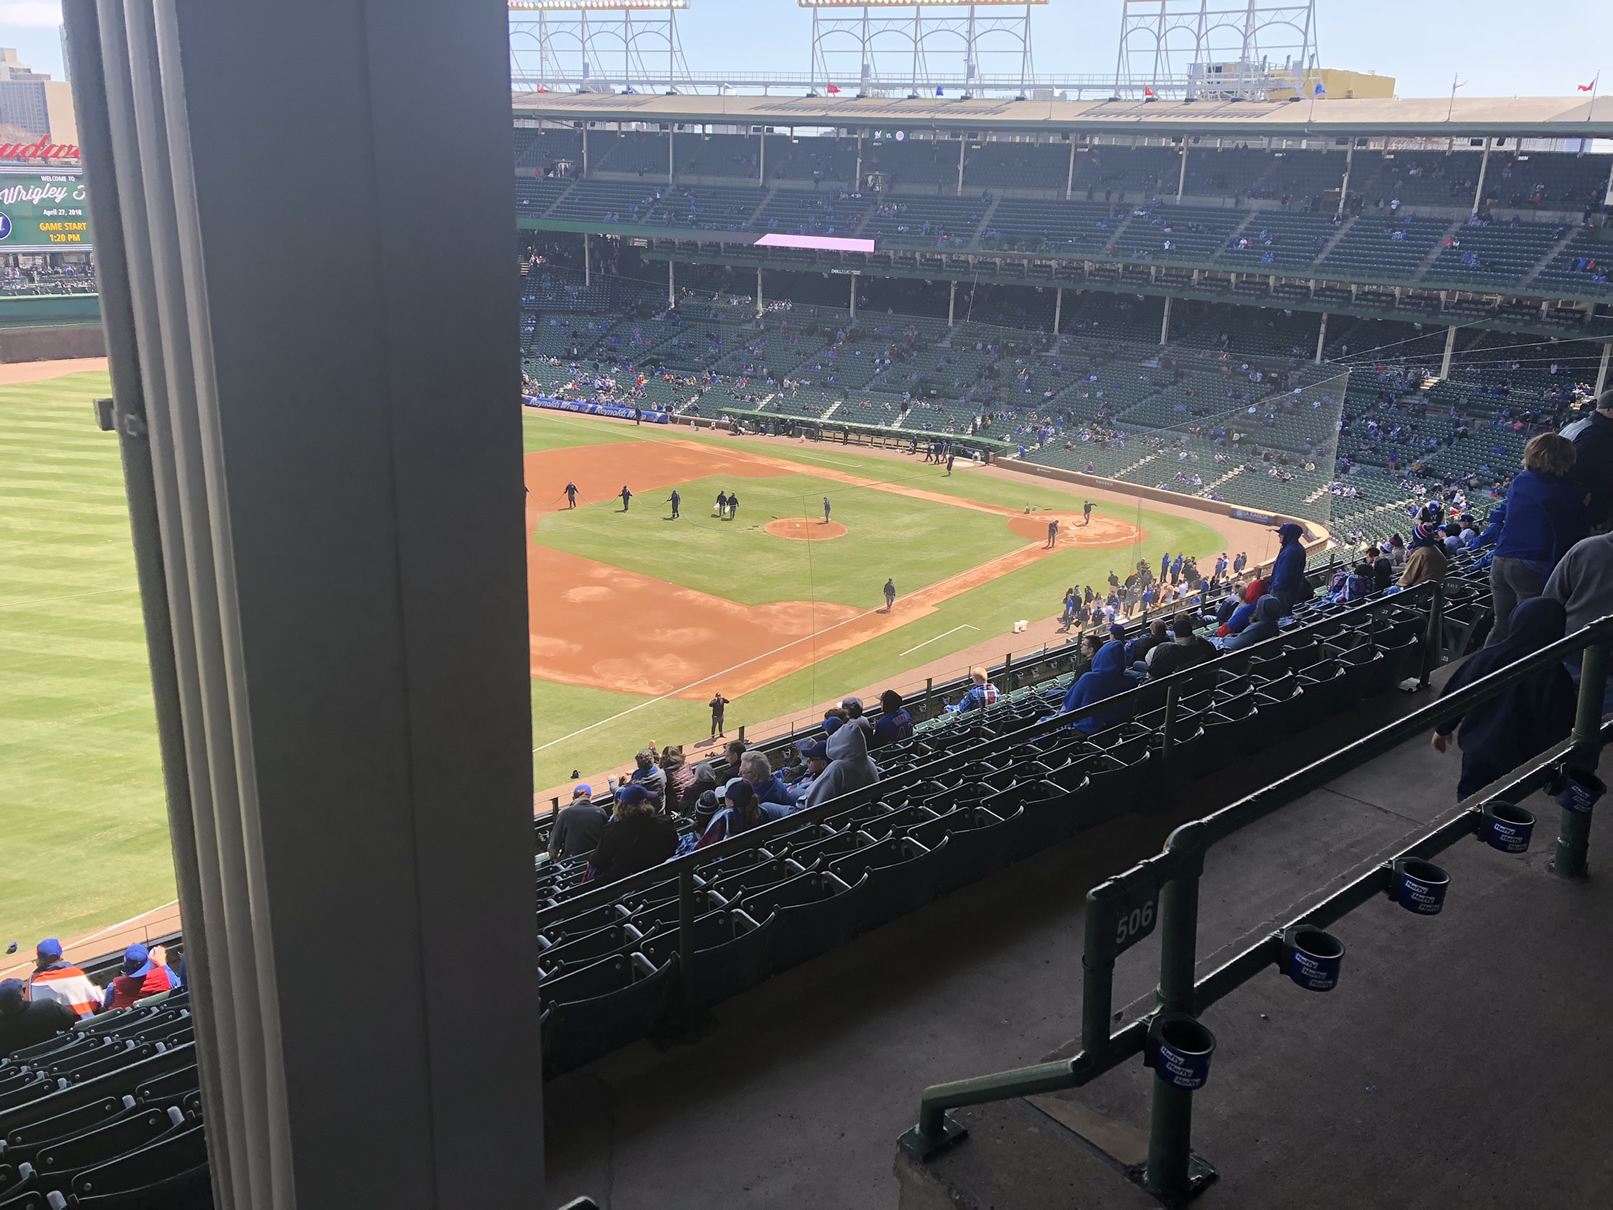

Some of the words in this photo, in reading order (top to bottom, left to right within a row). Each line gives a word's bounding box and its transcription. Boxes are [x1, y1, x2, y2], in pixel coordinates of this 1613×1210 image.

[0, 183, 67, 205] Wrigley
[43, 209, 58, 217] April
[39, 222, 63, 231] GAME
[64, 222, 87, 231] START
[49, 233, 66, 242] 1:20
[67, 233, 81, 242] PM
[529, 397, 560, 409] Reynolds
[560, 400, 579, 412] Wrap
[594, 404, 627, 417] Reynolds
[1405, 880, 1429, 894] Hefty
[1116, 900, 1153, 944] 506
[1160, 1045, 1184, 1065] Hefty
[1166, 1061, 1194, 1077] Hefty
